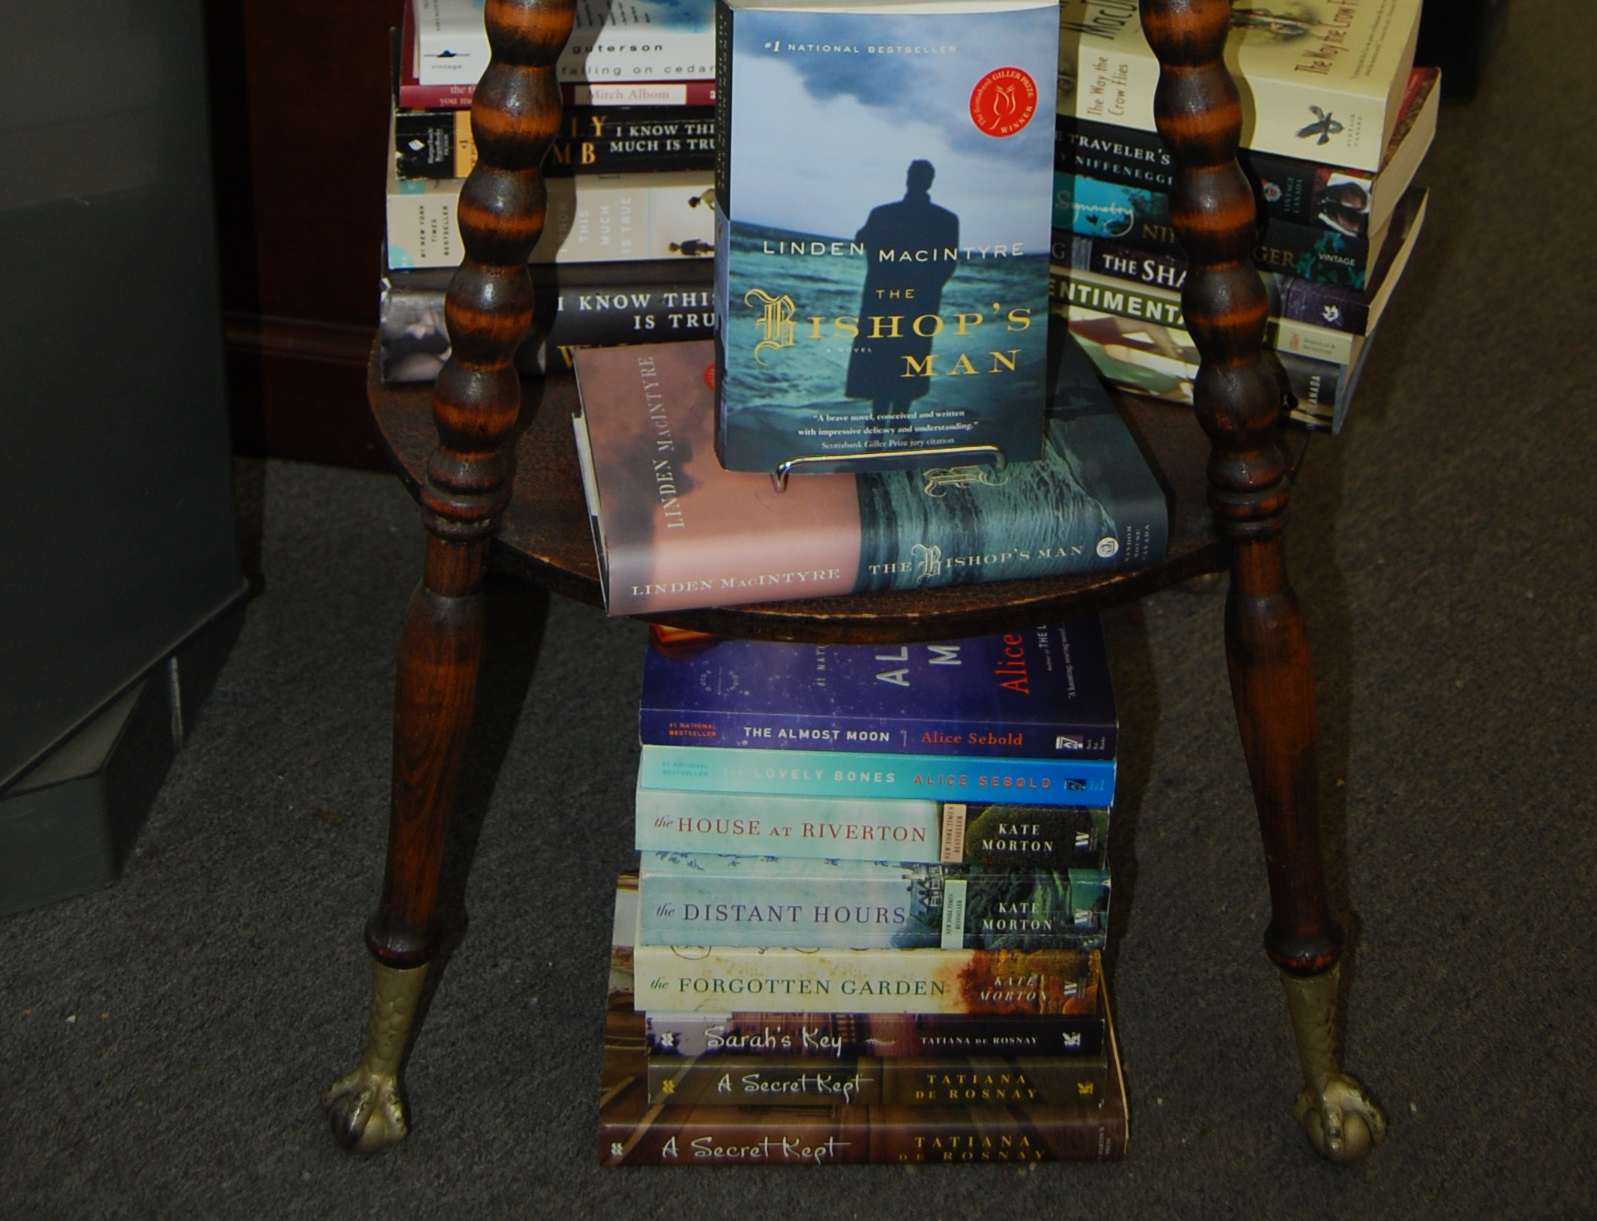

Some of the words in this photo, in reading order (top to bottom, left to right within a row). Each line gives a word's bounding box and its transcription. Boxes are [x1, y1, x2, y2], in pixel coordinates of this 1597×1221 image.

[572, 43, 664, 54] guterson
[764, 41, 780, 53] #1
[787, 43, 860, 53] NATIONAL
[868, 44, 957, 54] BESTSELLER
[629, 125, 680, 137] KNOW
[609, 140, 659, 153] MUCH
[666, 139, 681, 151] IS
[763, 241, 865, 256] LINDEN
[876, 289, 915, 299] THE
[579, 293, 652, 310] KNOW
[634, 315, 655, 329] IS
[901, 349, 1021, 377] MAN
[826, 414, 849, 422] brave
[876, 411, 917, 421] conceived
[818, 427, 862, 438] impressive
[821, 440, 862, 449] Scotiabank
[864, 439, 887, 448] Giller
[653, 459, 684, 529] LINDEN
[869, 561, 912, 575] THE
[1038, 545, 1084, 560] MAN
[630, 580, 715, 596] LINDEN
[995, 633, 1029, 694] Alice
[744, 727, 772, 738] THE
[778, 729, 841, 741] ALMOST
[846, 731, 890, 742] MOON
[921, 731, 962, 744] Alice
[968, 733, 1023, 746] Sebold
[834, 770, 895, 783] BONES
[912, 773, 968, 786] ALICE
[978, 776, 1051, 789] SEBOLD
[654, 815, 674, 829] the
[678, 818, 761, 835] HOUSE
[769, 826, 792, 837] AT
[802, 823, 927, 842] RIVERTON
[999, 823, 1040, 836] KATE
[982, 839, 1053, 852] MORTON
[656, 902, 675, 917] the
[684, 904, 803, 923] DISTANT
[814, 906, 906, 924] HOURS
[999, 902, 1039, 914] KATE
[982, 919, 1052, 931] MORTON
[650, 976, 669, 989] the
[679, 978, 830, 995] FORGOTTEN
[841, 980, 945, 996] GARDEN
[705, 1026, 792, 1049] Sarah's
[802, 1026, 842, 1057] Key
[921, 1036, 970, 1045] TATIANA
[993, 1036, 1038, 1045] ROSNAY
[928, 1074, 1026, 1084] TATIANA
[718, 1073, 732, 1093] A
[741, 1073, 808, 1093] Secret
[817, 1073, 874, 1104] Kept
[916, 1090, 936, 1099] DE
[950, 1089, 1037, 1099] ROSNAY
[915, 1136, 1031, 1148] TATIANA
[662, 1136, 678, 1158] A
[691, 1136, 769, 1158] Secret
[783, 1136, 851, 1165] Kept
[943, 1150, 1045, 1161] ROSNAY
